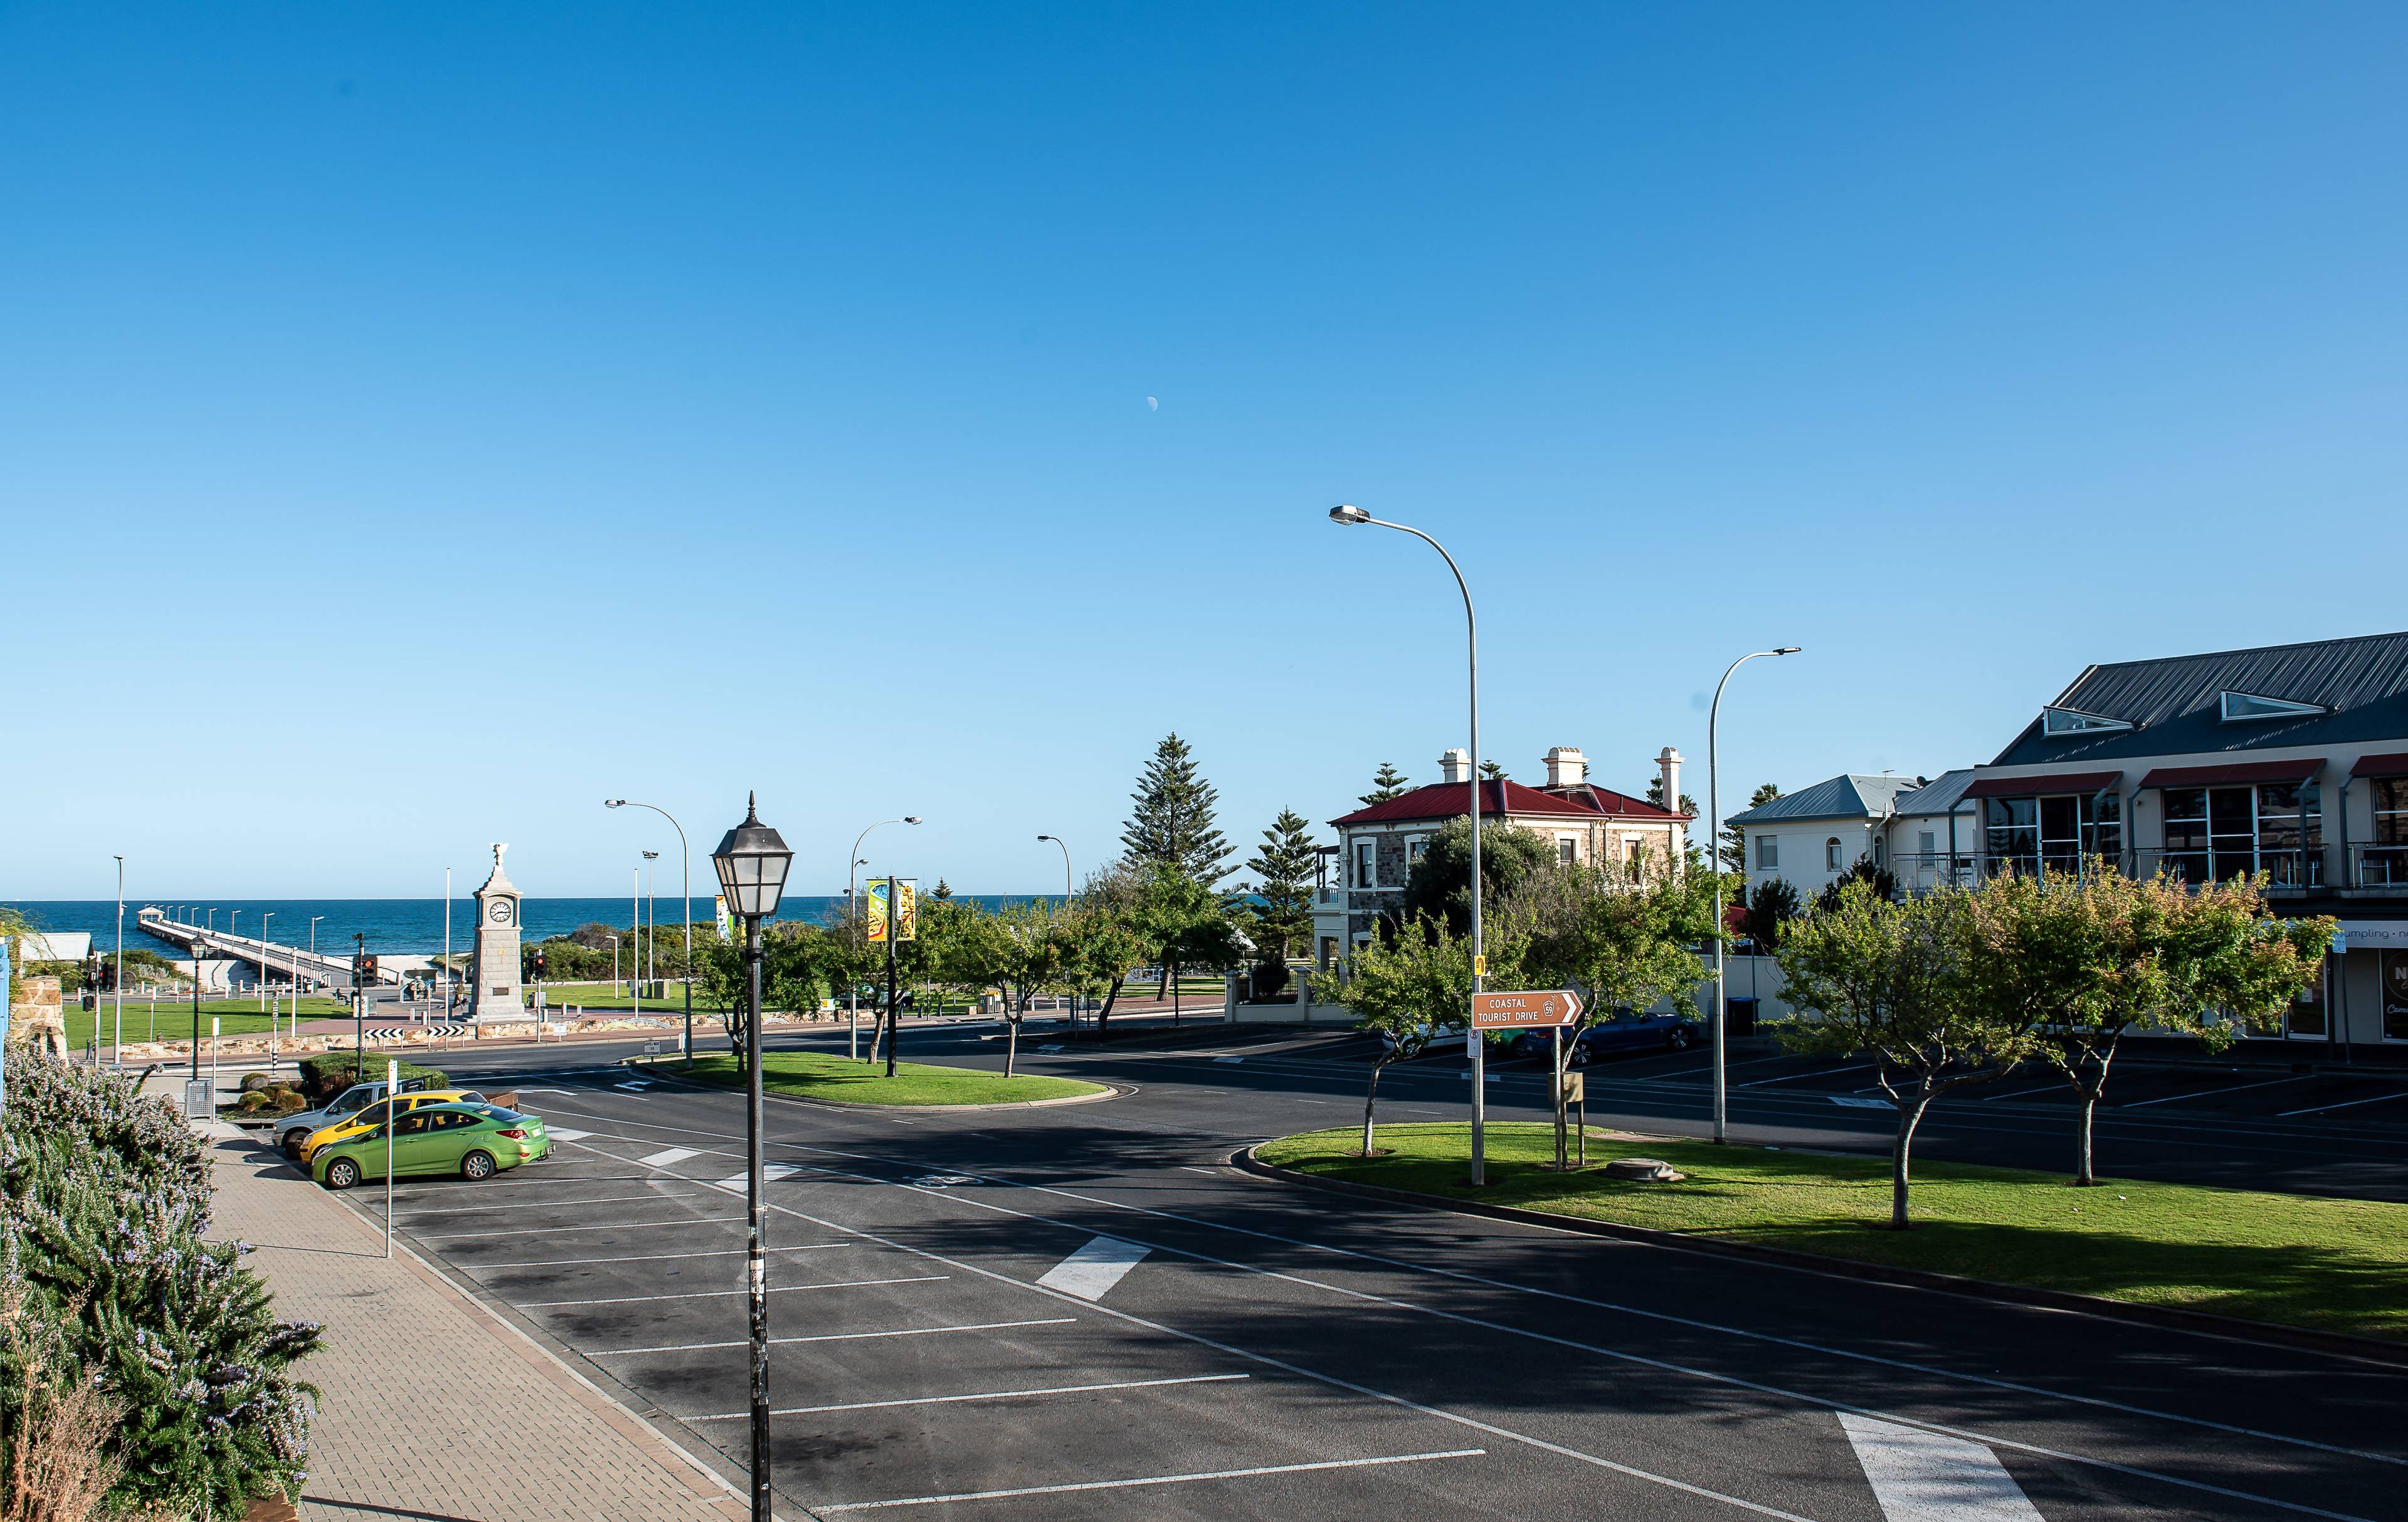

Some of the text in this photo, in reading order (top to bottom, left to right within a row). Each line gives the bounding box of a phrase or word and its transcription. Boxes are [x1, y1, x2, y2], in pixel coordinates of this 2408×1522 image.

[1489, 998, 1526, 1009] COASTAL
[1545, 1006, 1552, 1014] 59
[1478, 1012, 1538, 1022] TOURIST DRIVE
